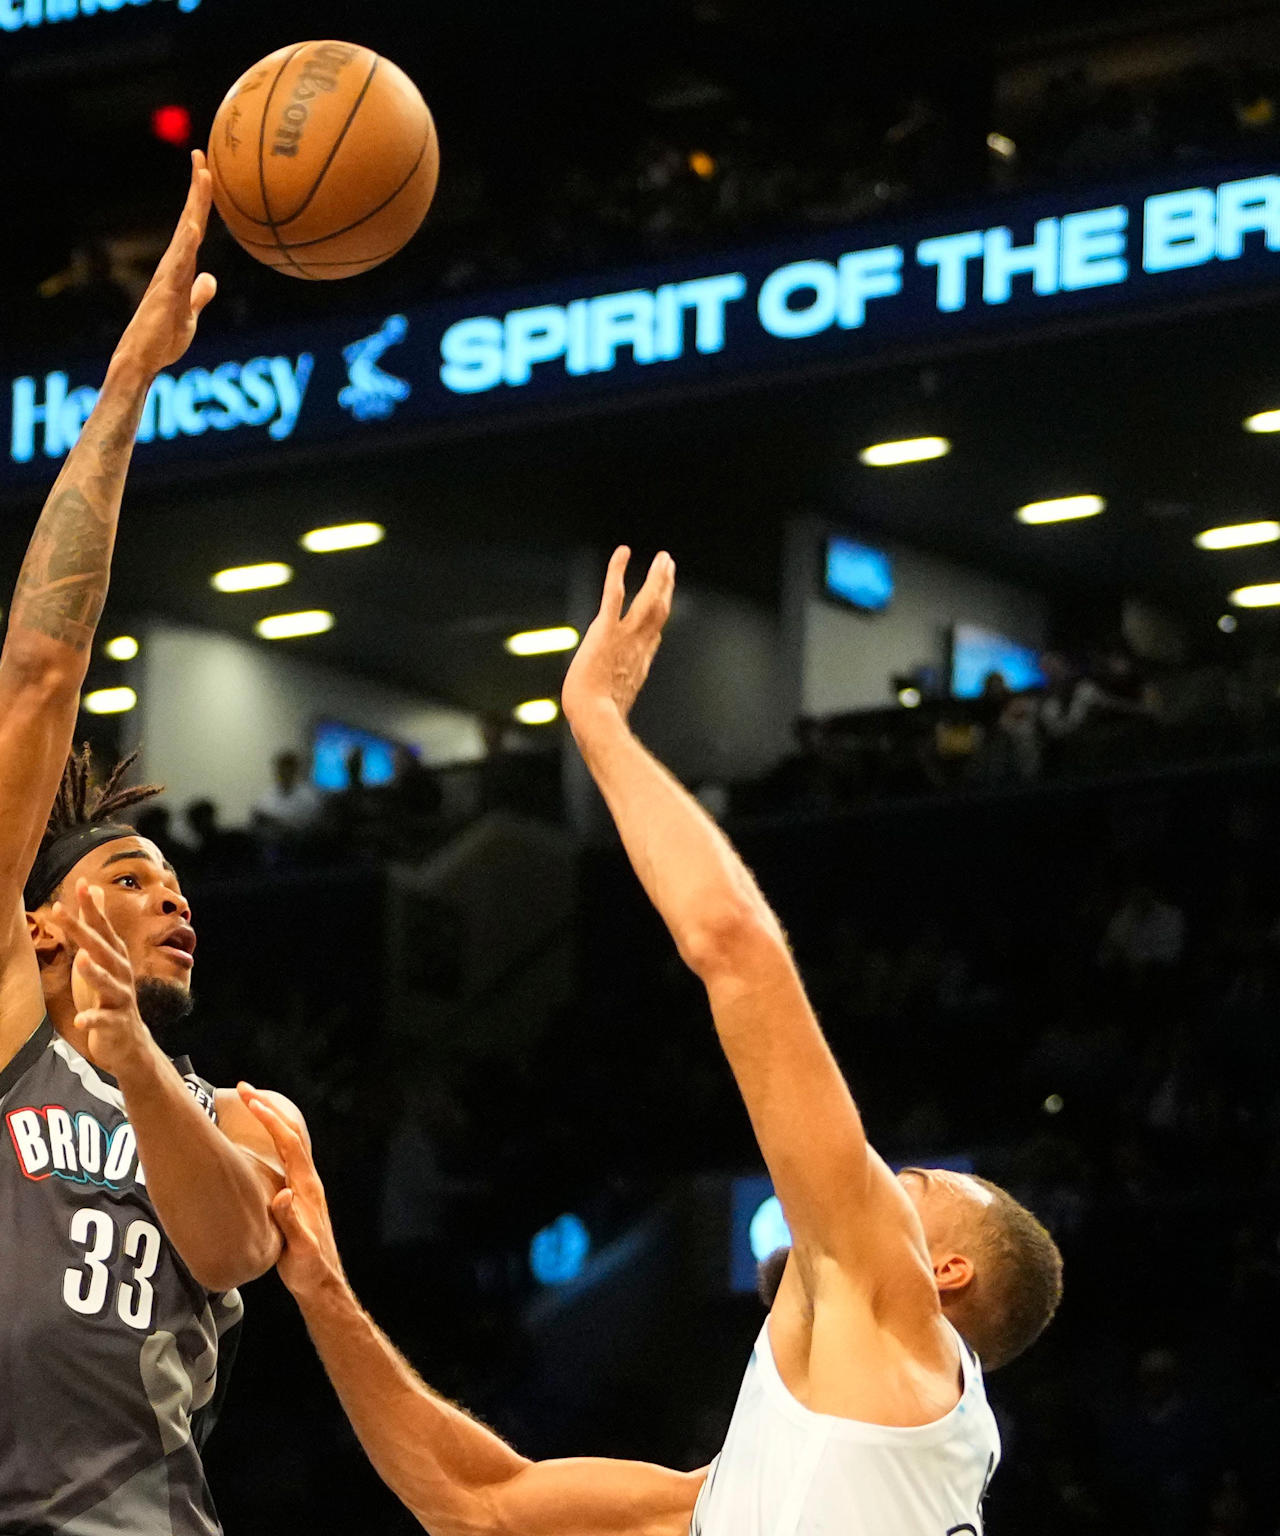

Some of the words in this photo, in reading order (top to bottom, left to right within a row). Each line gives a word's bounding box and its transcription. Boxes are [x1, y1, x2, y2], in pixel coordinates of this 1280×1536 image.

[439, 272, 746, 394] SPIRIT
[757, 244, 903, 338] OF
[917, 204, 1129, 312] THE
[11, 352, 314, 462] Henessy
[8, 1106, 147, 1187] BROO
[63, 1208, 162, 1330] 33
